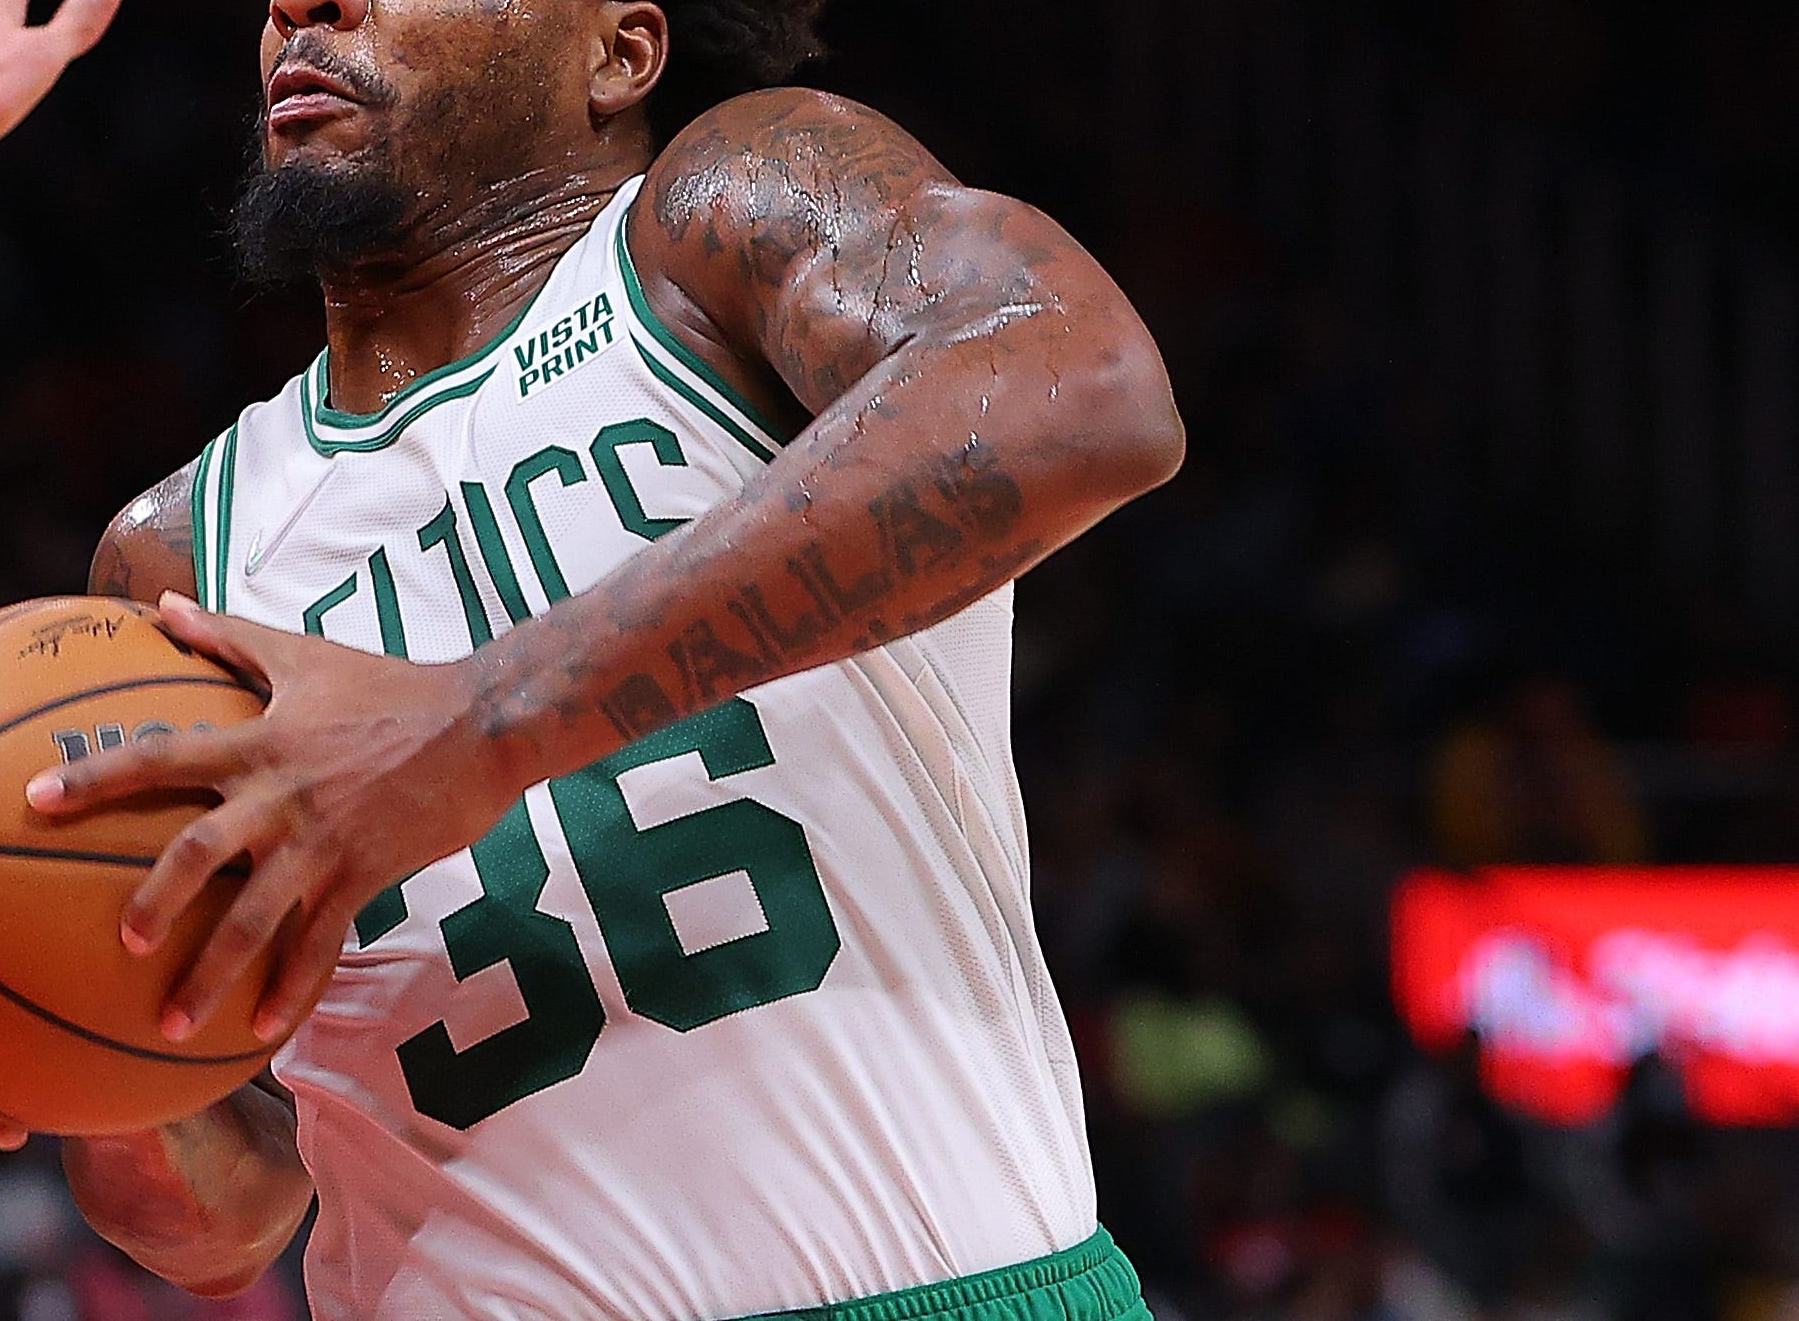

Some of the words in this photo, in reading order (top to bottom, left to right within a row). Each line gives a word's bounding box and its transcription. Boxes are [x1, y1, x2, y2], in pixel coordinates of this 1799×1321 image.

[513, 291, 614, 372] VISTA
[519, 315, 615, 399] PRINT
[353, 695, 842, 1131] 36
